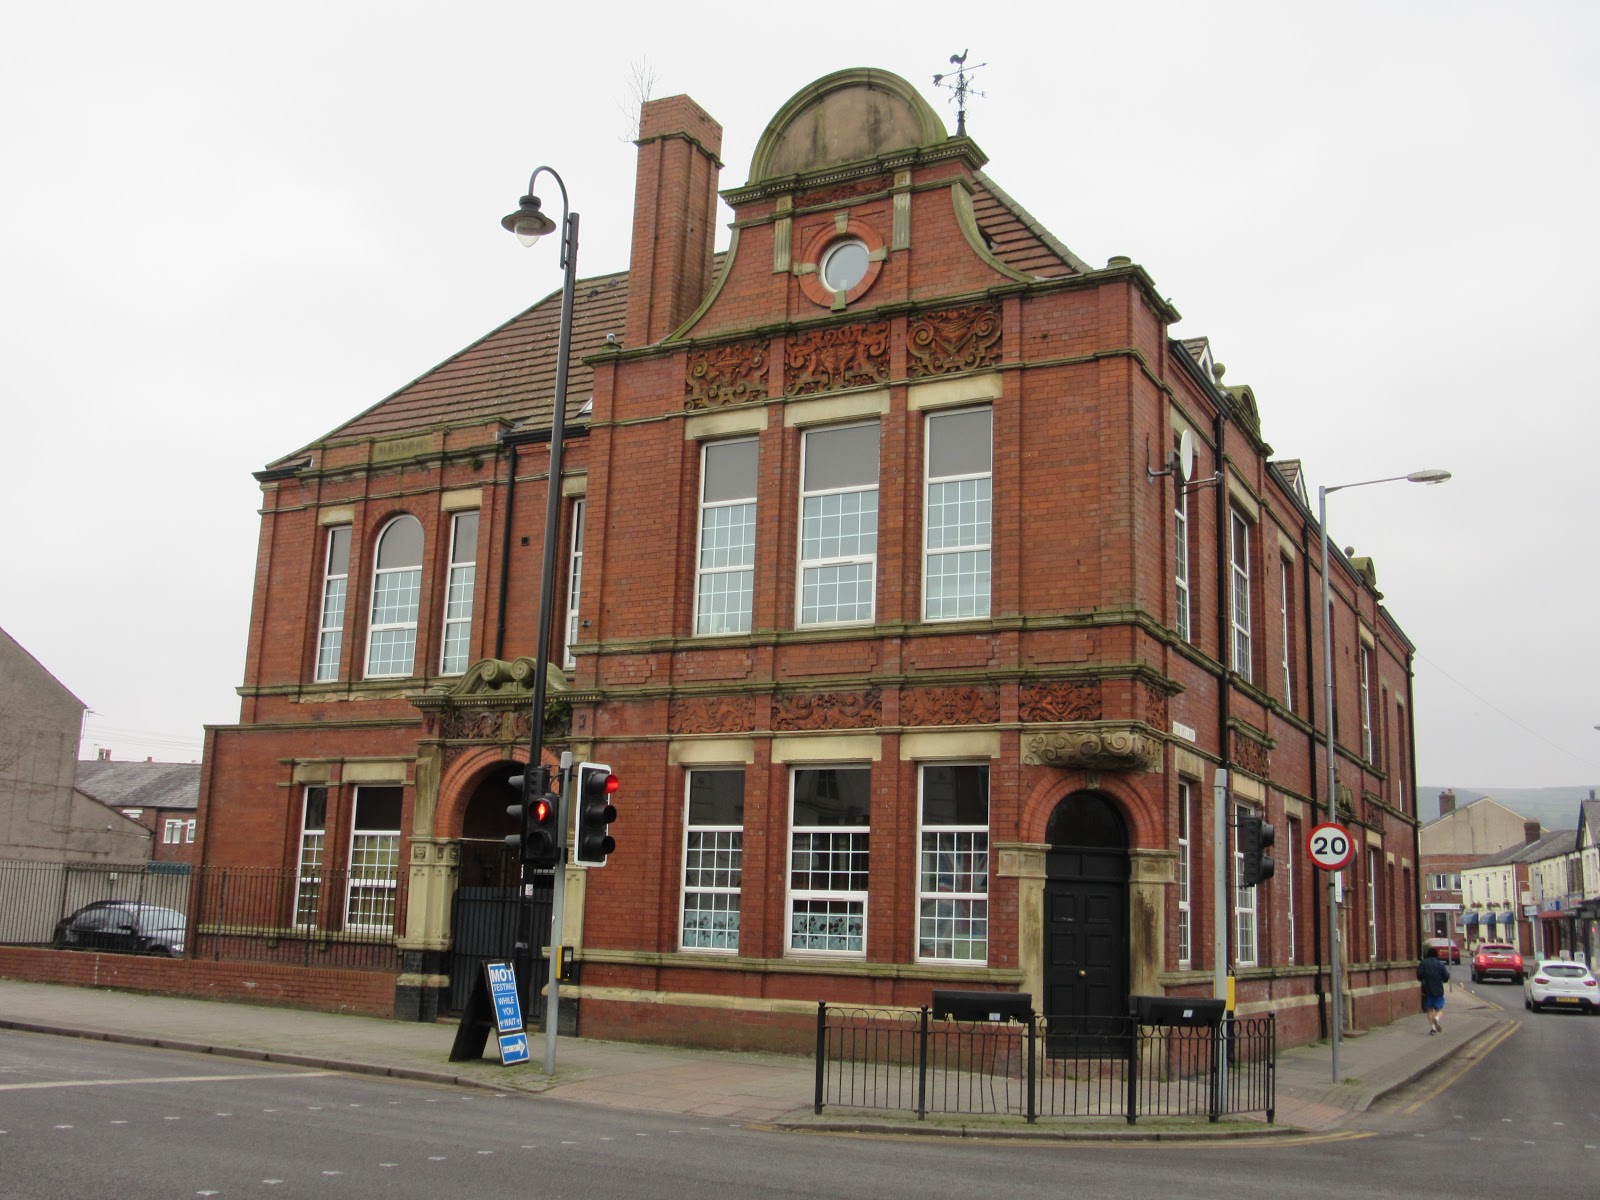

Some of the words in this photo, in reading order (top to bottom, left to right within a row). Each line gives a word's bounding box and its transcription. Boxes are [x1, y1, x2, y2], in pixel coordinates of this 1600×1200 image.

[1313, 836, 1346, 856] 20
[490, 968, 513, 983] MOT
[493, 983, 515, 992] TESTING
[497, 996, 515, 1005] WHILE
[502, 1007, 514, 1016] YOU
[503, 1017, 517, 1027] WAIT
